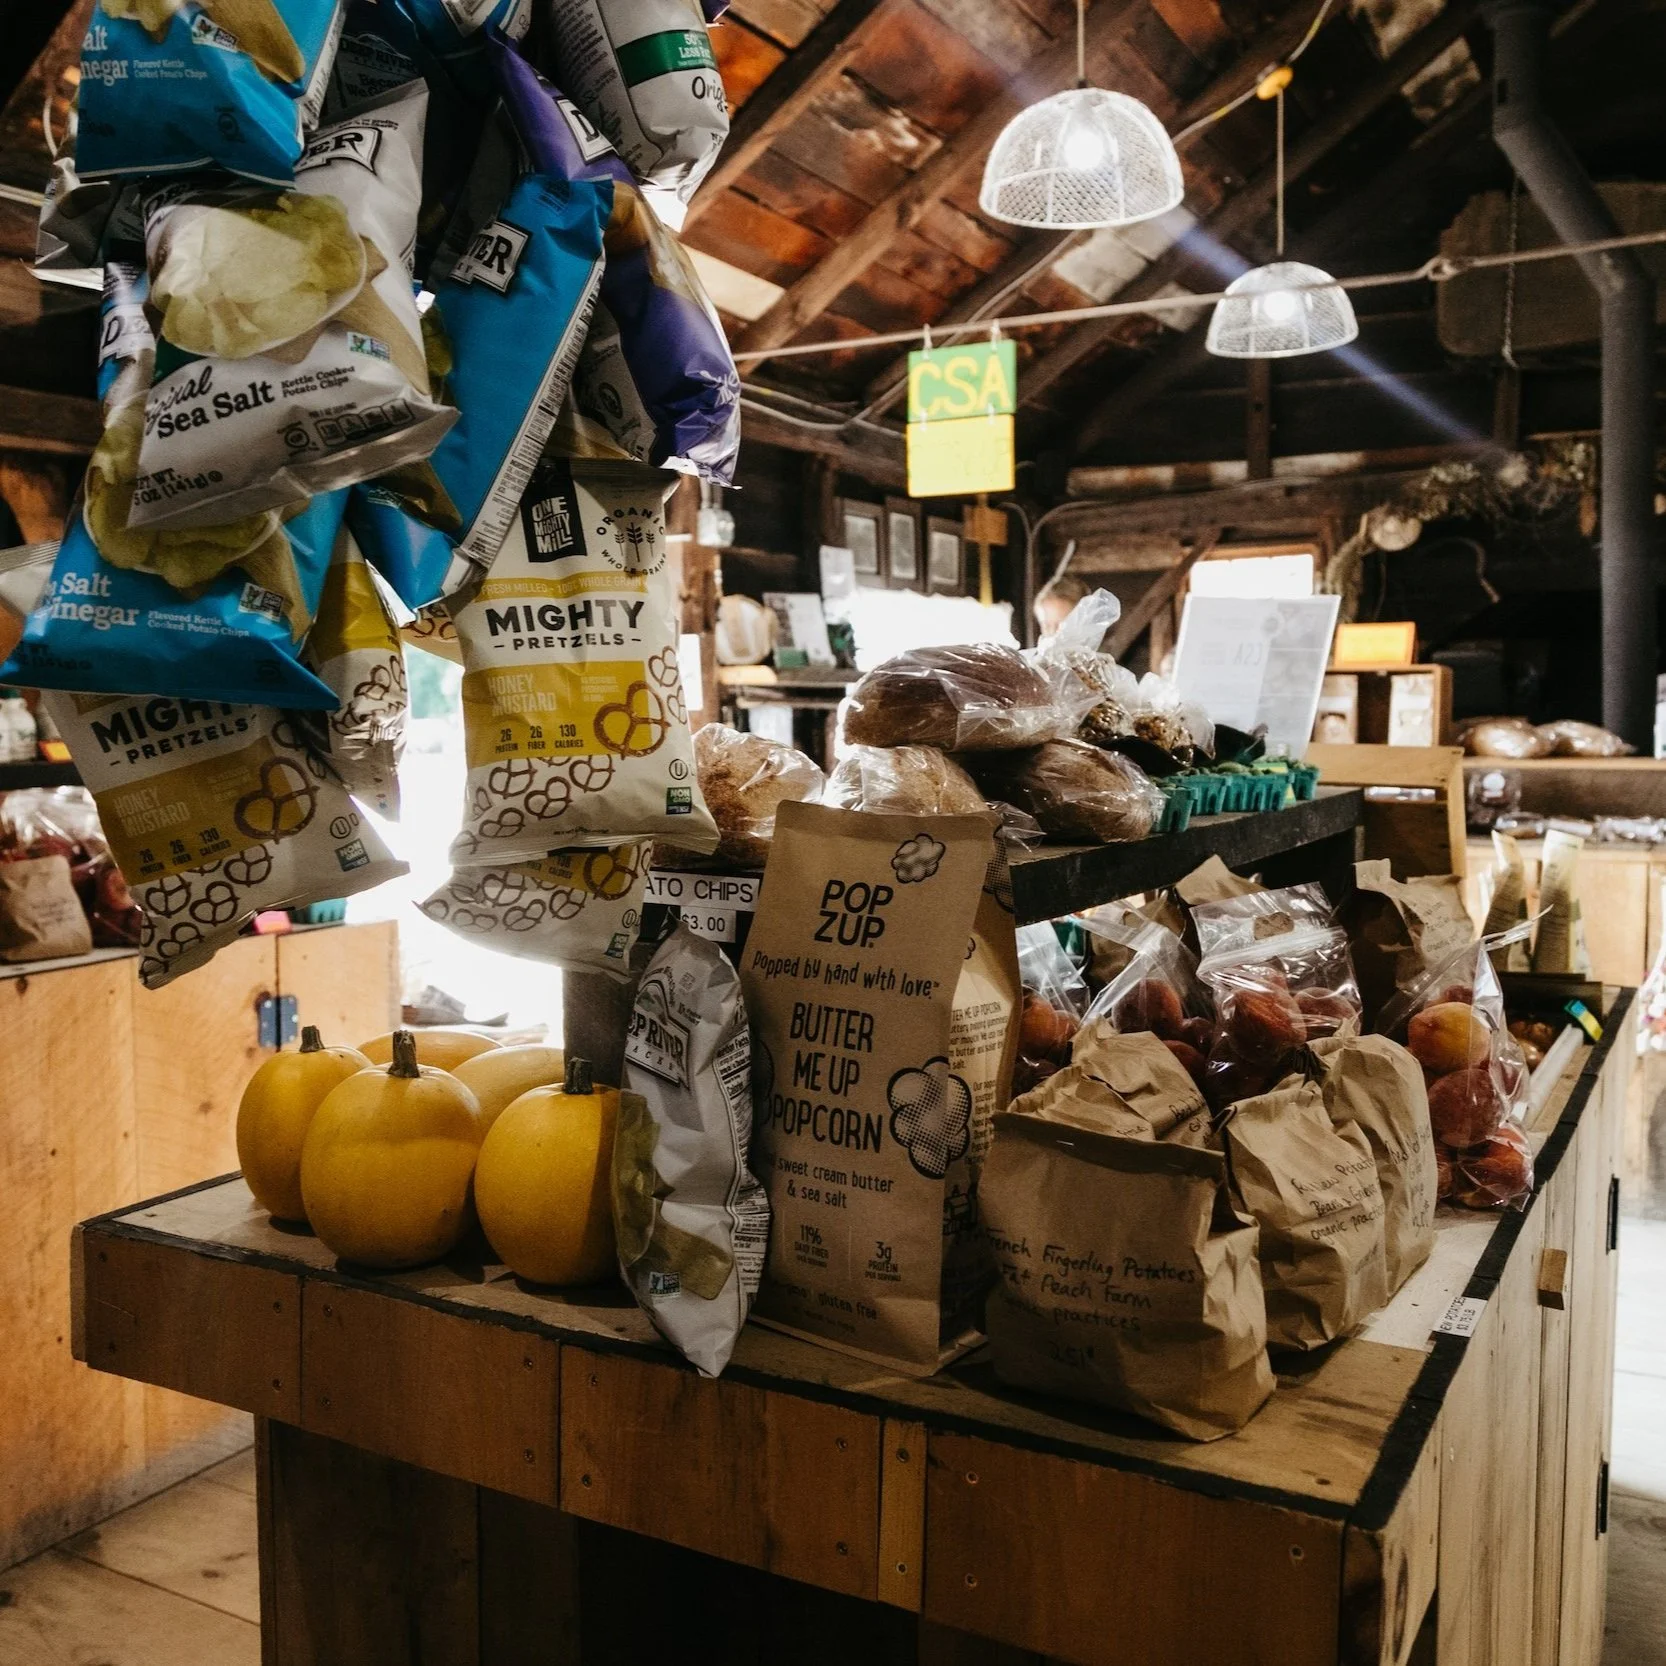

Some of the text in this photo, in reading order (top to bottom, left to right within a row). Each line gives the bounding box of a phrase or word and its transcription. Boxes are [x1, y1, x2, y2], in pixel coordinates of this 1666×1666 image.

[82, 26, 108, 51] alt
[80, 60, 129, 87] negar
[280, 366, 356, 390] Kettle Cooked
[282, 375, 350, 398] Potato Chips
[908, 355, 1012, 417] CSA
[157, 380, 275, 439] Sea Salt
[531, 496, 567, 522] ONE
[596, 506, 664, 536] ORGANIC
[601, 549, 637, 575] WHOLE
[60, 572, 113, 597] Salt
[481, 582, 512, 596] FRESH
[513, 582, 547, 594] MILLED
[579, 576, 611, 588] WHOLE
[147, 610, 222, 626] Flavored Kettle
[147, 619, 250, 638] Cooked Potato Chips
[485, 599, 644, 637] MIGHTY
[513, 633, 625, 650] PRETZELS
[488, 672, 535, 695] HONEY
[491, 691, 557, 717] MUSTARD
[126, 717, 248, 764] PRETZELS
[559, 723, 577, 737] 130
[528, 740, 546, 750] FIBER
[554, 739, 584, 749] CALORIES
[113, 786, 160, 818] HONEY
[670, 789, 690, 798] NON
[121, 800, 191, 838] MUSTARD
[645, 876, 755, 903] ATO CHIPS
[821, 879, 894, 914] POP
[681, 913, 726, 932] $3.00
[752, 950, 801, 978] popped
[803, 957, 821, 979] by
[824, 962, 860, 985] hand
[863, 966, 896, 991] with
[790, 1002, 874, 1053] BUTTER
[793, 1050, 827, 1092] ME
[828, 1055, 861, 1098] UP
[772, 1094, 883, 1153] POPCORN
[778, 1157, 895, 1194] sweet cream butter
[786, 1179, 848, 1209] & sea salt
[800, 1224, 823, 1245] 11%
[876, 1241, 892, 1261] 3g
[1042, 1244, 1114, 1284] Fingerling
[1123, 1257, 1196, 1284] Potatoes
[868, 1260, 899, 1273] PROTEIN
[1040, 1274, 1092, 1299] Peach
[1104, 1284, 1151, 1309] Farm
[818, 1292, 853, 1313] gluten
[856, 1301, 878, 1320] free
[1054, 1307, 1142, 1332] practices
